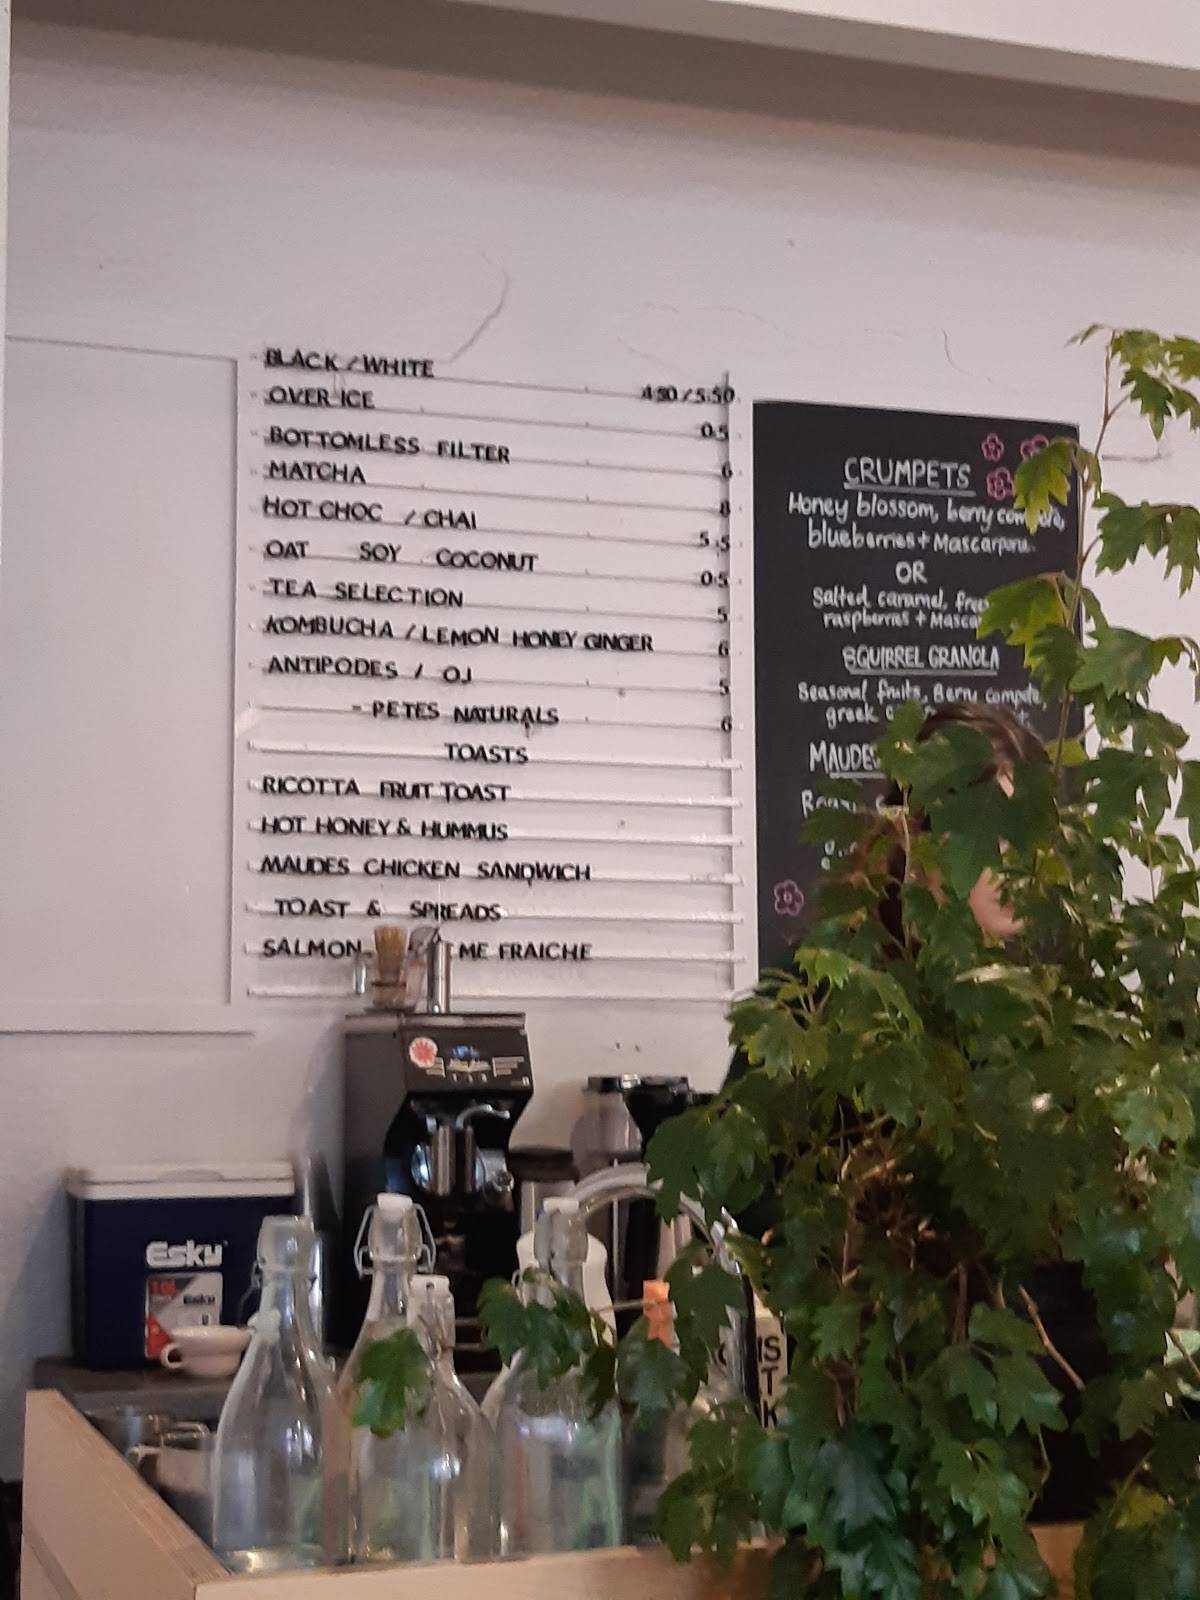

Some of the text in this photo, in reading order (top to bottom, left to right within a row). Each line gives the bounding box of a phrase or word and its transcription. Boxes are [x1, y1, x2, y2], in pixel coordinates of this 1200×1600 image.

[265, 348, 338, 372] BLACK
[363, 354, 435, 378] WHITE
[269, 386, 331, 407] OVER
[341, 389, 375, 409] ICE
[270, 425, 420, 454] BOTTOMLESS
[437, 440, 510, 464] FILTER
[269, 460, 367, 484] MATCHA
[844, 457, 971, 489] CRUMPETS
[263, 495, 312, 518] HOT
[319, 500, 383, 522] CHOC
[424, 508, 477, 529] CHAI
[789, 491, 848, 524] Honey
[857, 491, 939, 524] blossom,
[947, 498, 993, 534] berry
[809, 517, 915, 549] blueberries
[266, 540, 309, 558] OAT
[360, 541, 402, 562] SOY
[436, 548, 538, 572] COCONUT
[896, 561, 927, 584] OR
[269, 578, 317, 598] TEA
[335, 582, 463, 608] SELECTION
[266, 615, 394, 639] KOMBUCHA
[422, 625, 499, 647] LEMON
[513, 630, 577, 649] HONEY
[584, 633, 653, 652] GINGER
[268, 656, 398, 679] ANTIPODES
[443, 665, 472, 684] OJ
[842, 644, 999, 671] SQUIRREL GRANOLA
[798, 679, 867, 702] Seasonal
[372, 700, 440, 720] PETES
[453, 705, 560, 725] NATURALS
[444, 742, 529, 764] TOASTS
[262, 775, 511, 802] RICOTTA FRUIT TOAST
[261, 816, 509, 841] HOT HONEY & HUMMUS
[260, 855, 591, 881] MAUDES CHICKEN SANDWICH
[275, 898, 501, 921] TOAST & SPREADS
[263, 937, 362, 959] SALMON
[499, 942, 592, 961] FRAICHE
[146, 1240, 222, 1268] Esky
